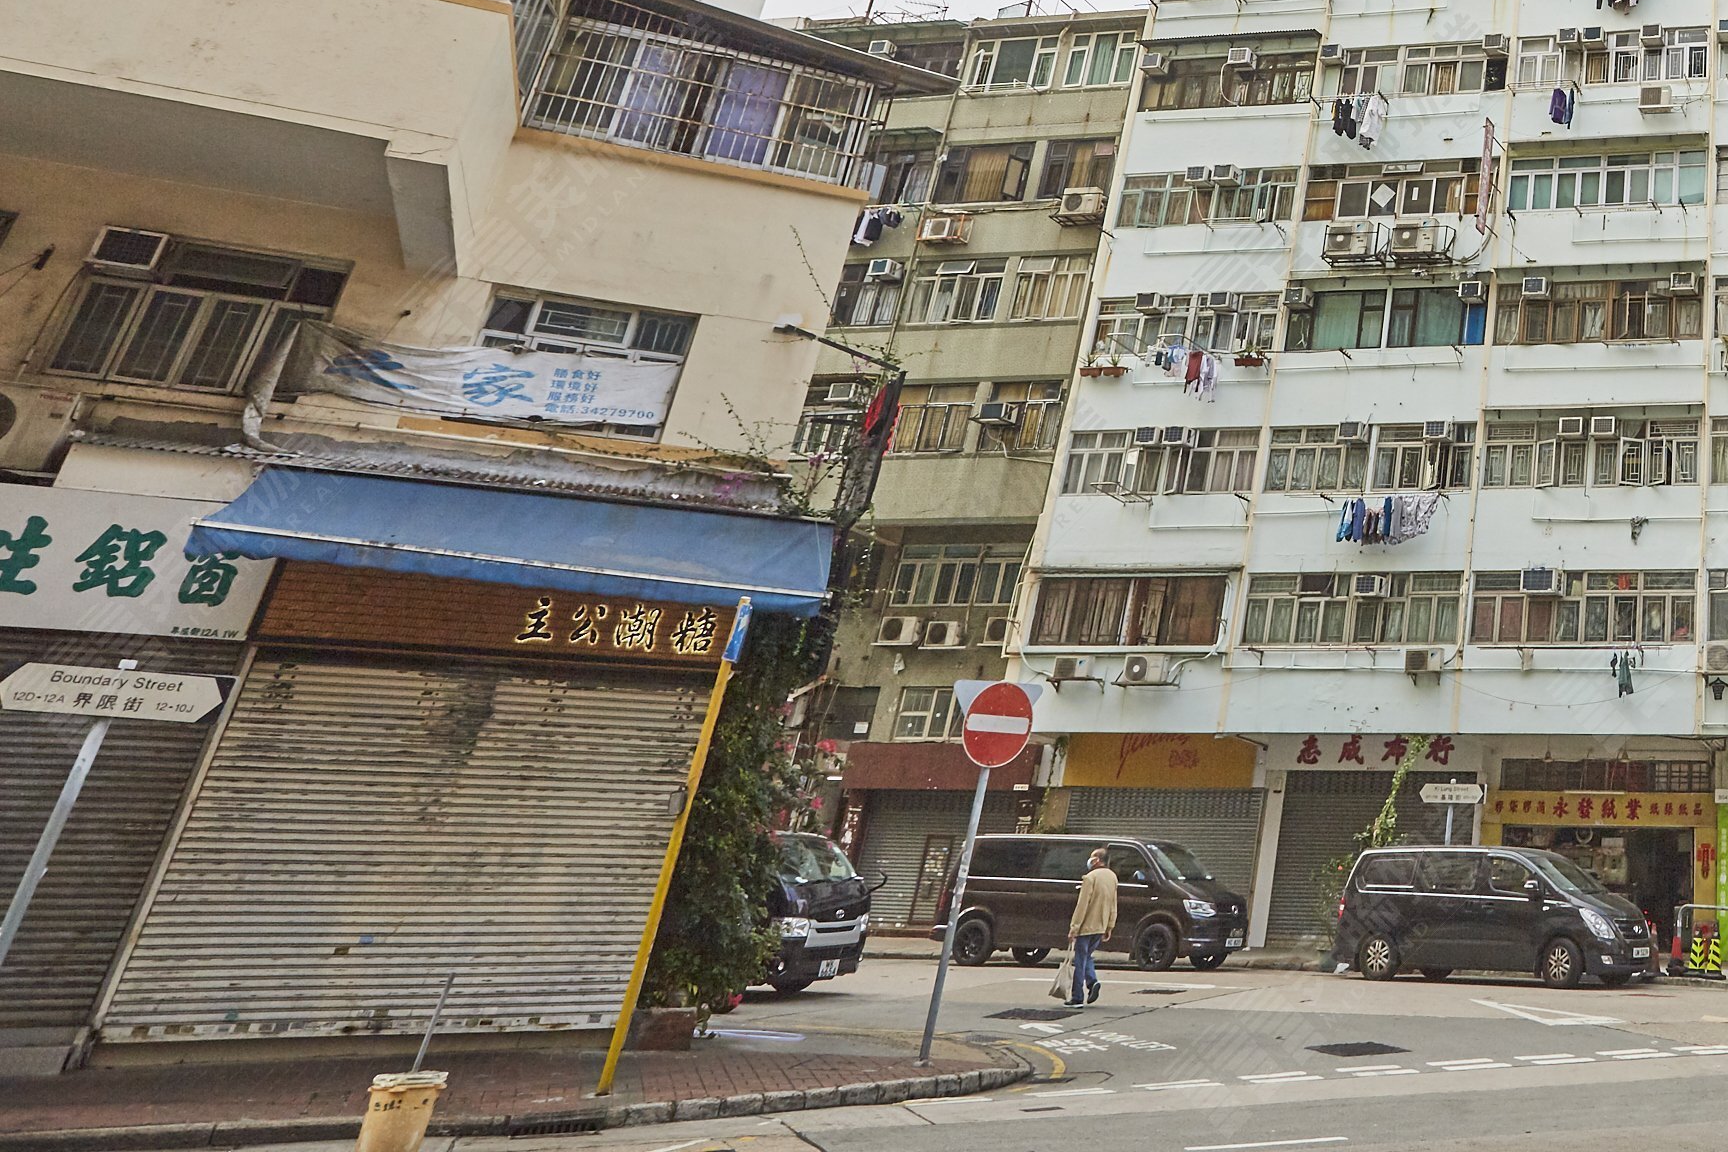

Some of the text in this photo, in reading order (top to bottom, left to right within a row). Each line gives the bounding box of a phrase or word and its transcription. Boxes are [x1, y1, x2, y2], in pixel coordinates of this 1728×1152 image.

[50, 670, 183, 692] Boundary Street
[72, 692, 144, 713] 界限街
